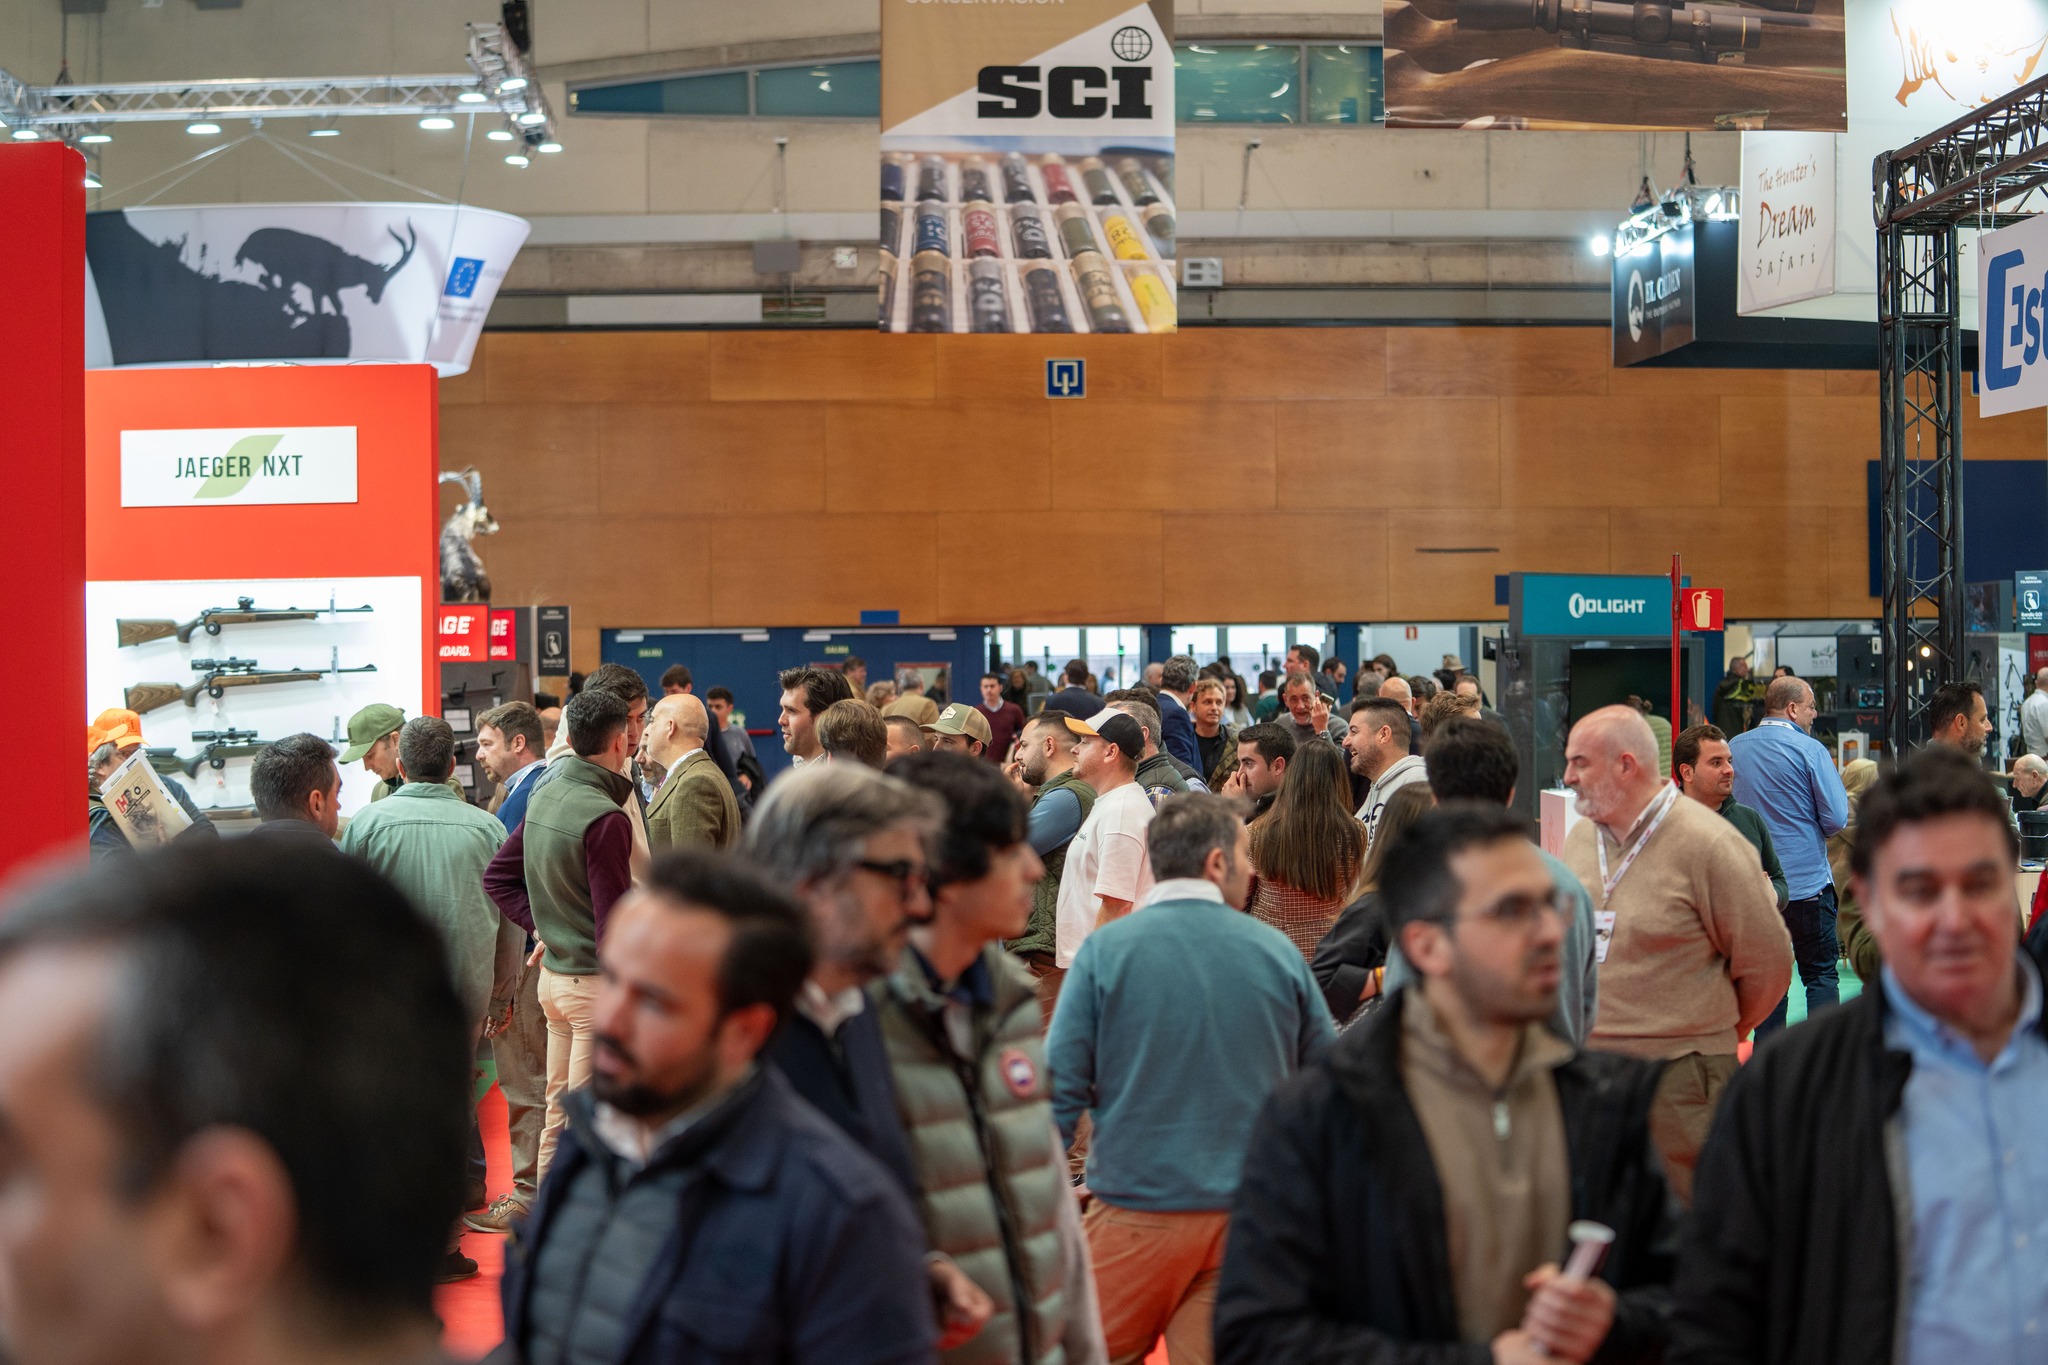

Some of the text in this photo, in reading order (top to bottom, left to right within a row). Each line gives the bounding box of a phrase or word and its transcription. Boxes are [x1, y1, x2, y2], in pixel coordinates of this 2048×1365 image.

[978, 66, 1153, 119] SCI
[1759, 153, 1816, 192] The Hunter's
[1757, 201, 1816, 249] Dream
[175, 455, 303, 478] JAEGER NXT
